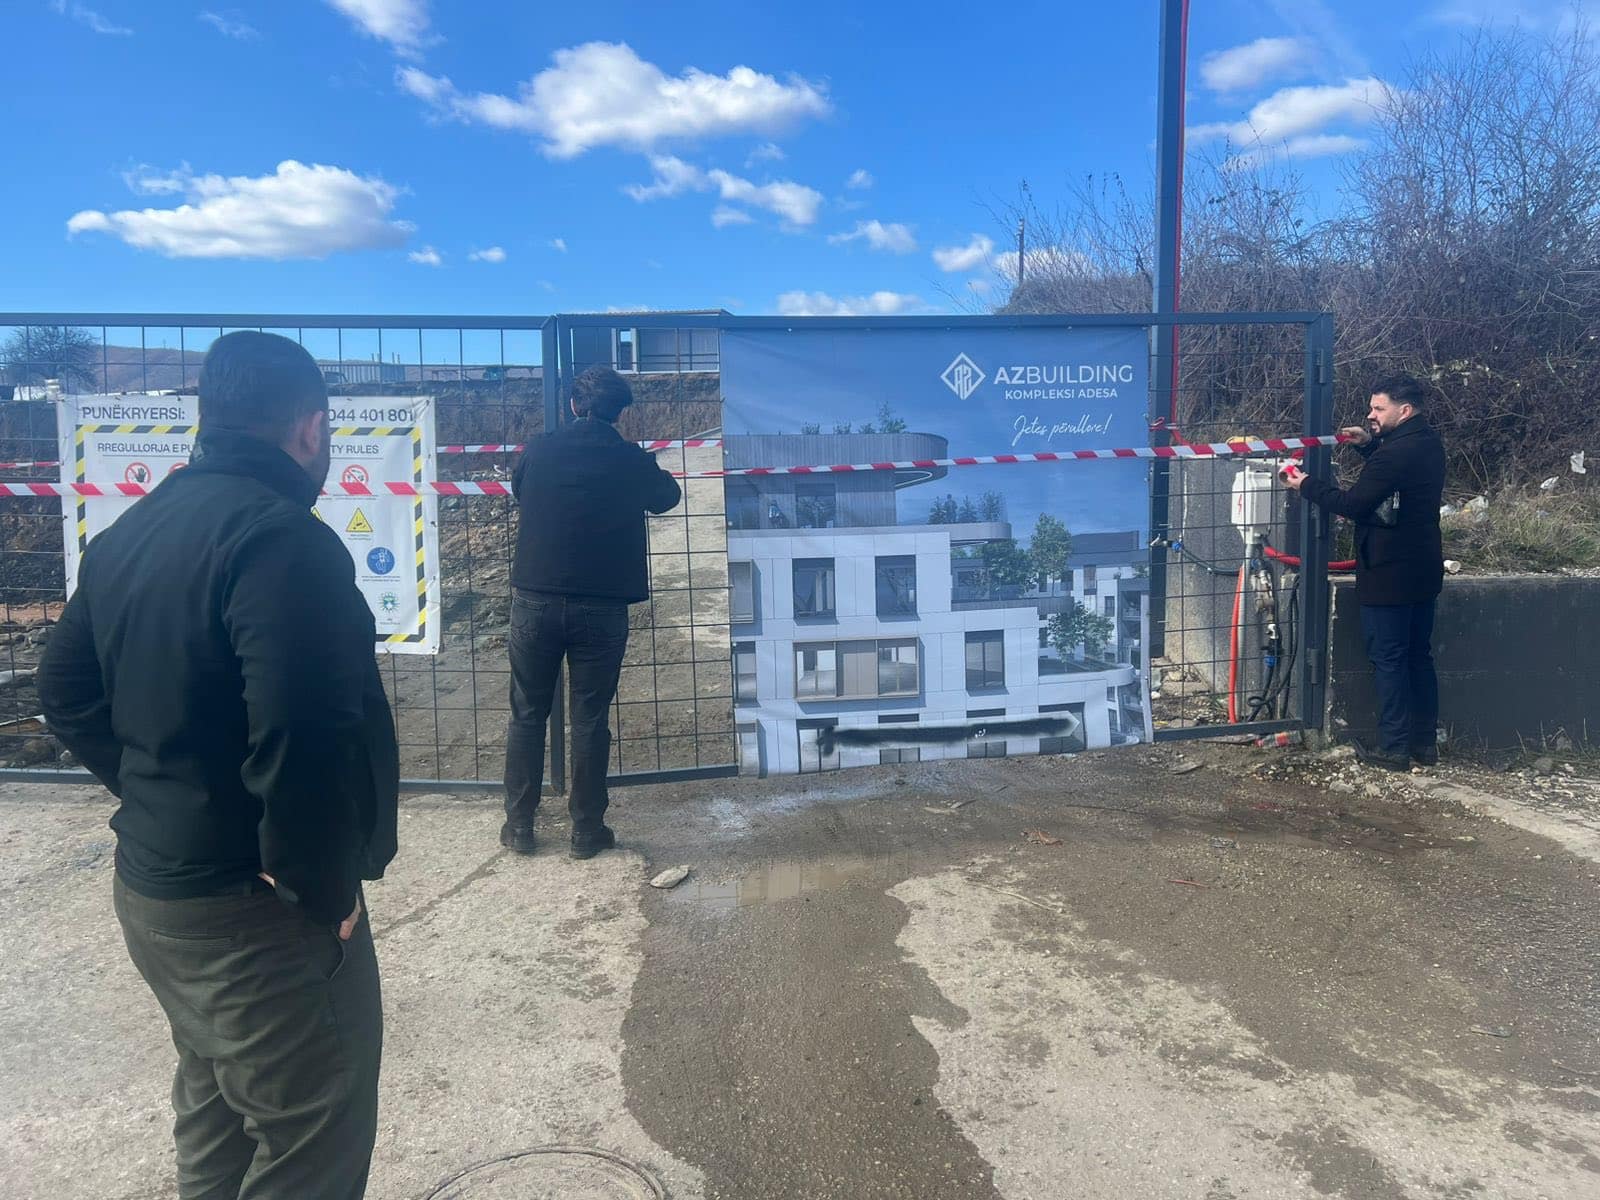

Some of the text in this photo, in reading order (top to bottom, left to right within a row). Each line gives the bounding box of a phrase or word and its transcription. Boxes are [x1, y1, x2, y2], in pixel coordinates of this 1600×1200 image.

[993, 365, 1133, 385] AZBUILDING
[1005, 388, 1118, 400] KOMPLEKSI ADESA
[82, 404, 185, 420] PUNËKRYERSI:
[360, 409, 384, 422] 401
[387, 409, 414, 422] 801
[97, 442, 170, 453] RREGULLORJA
[172, 443, 180, 453] E
[329, 444, 380, 455] TY RULES
